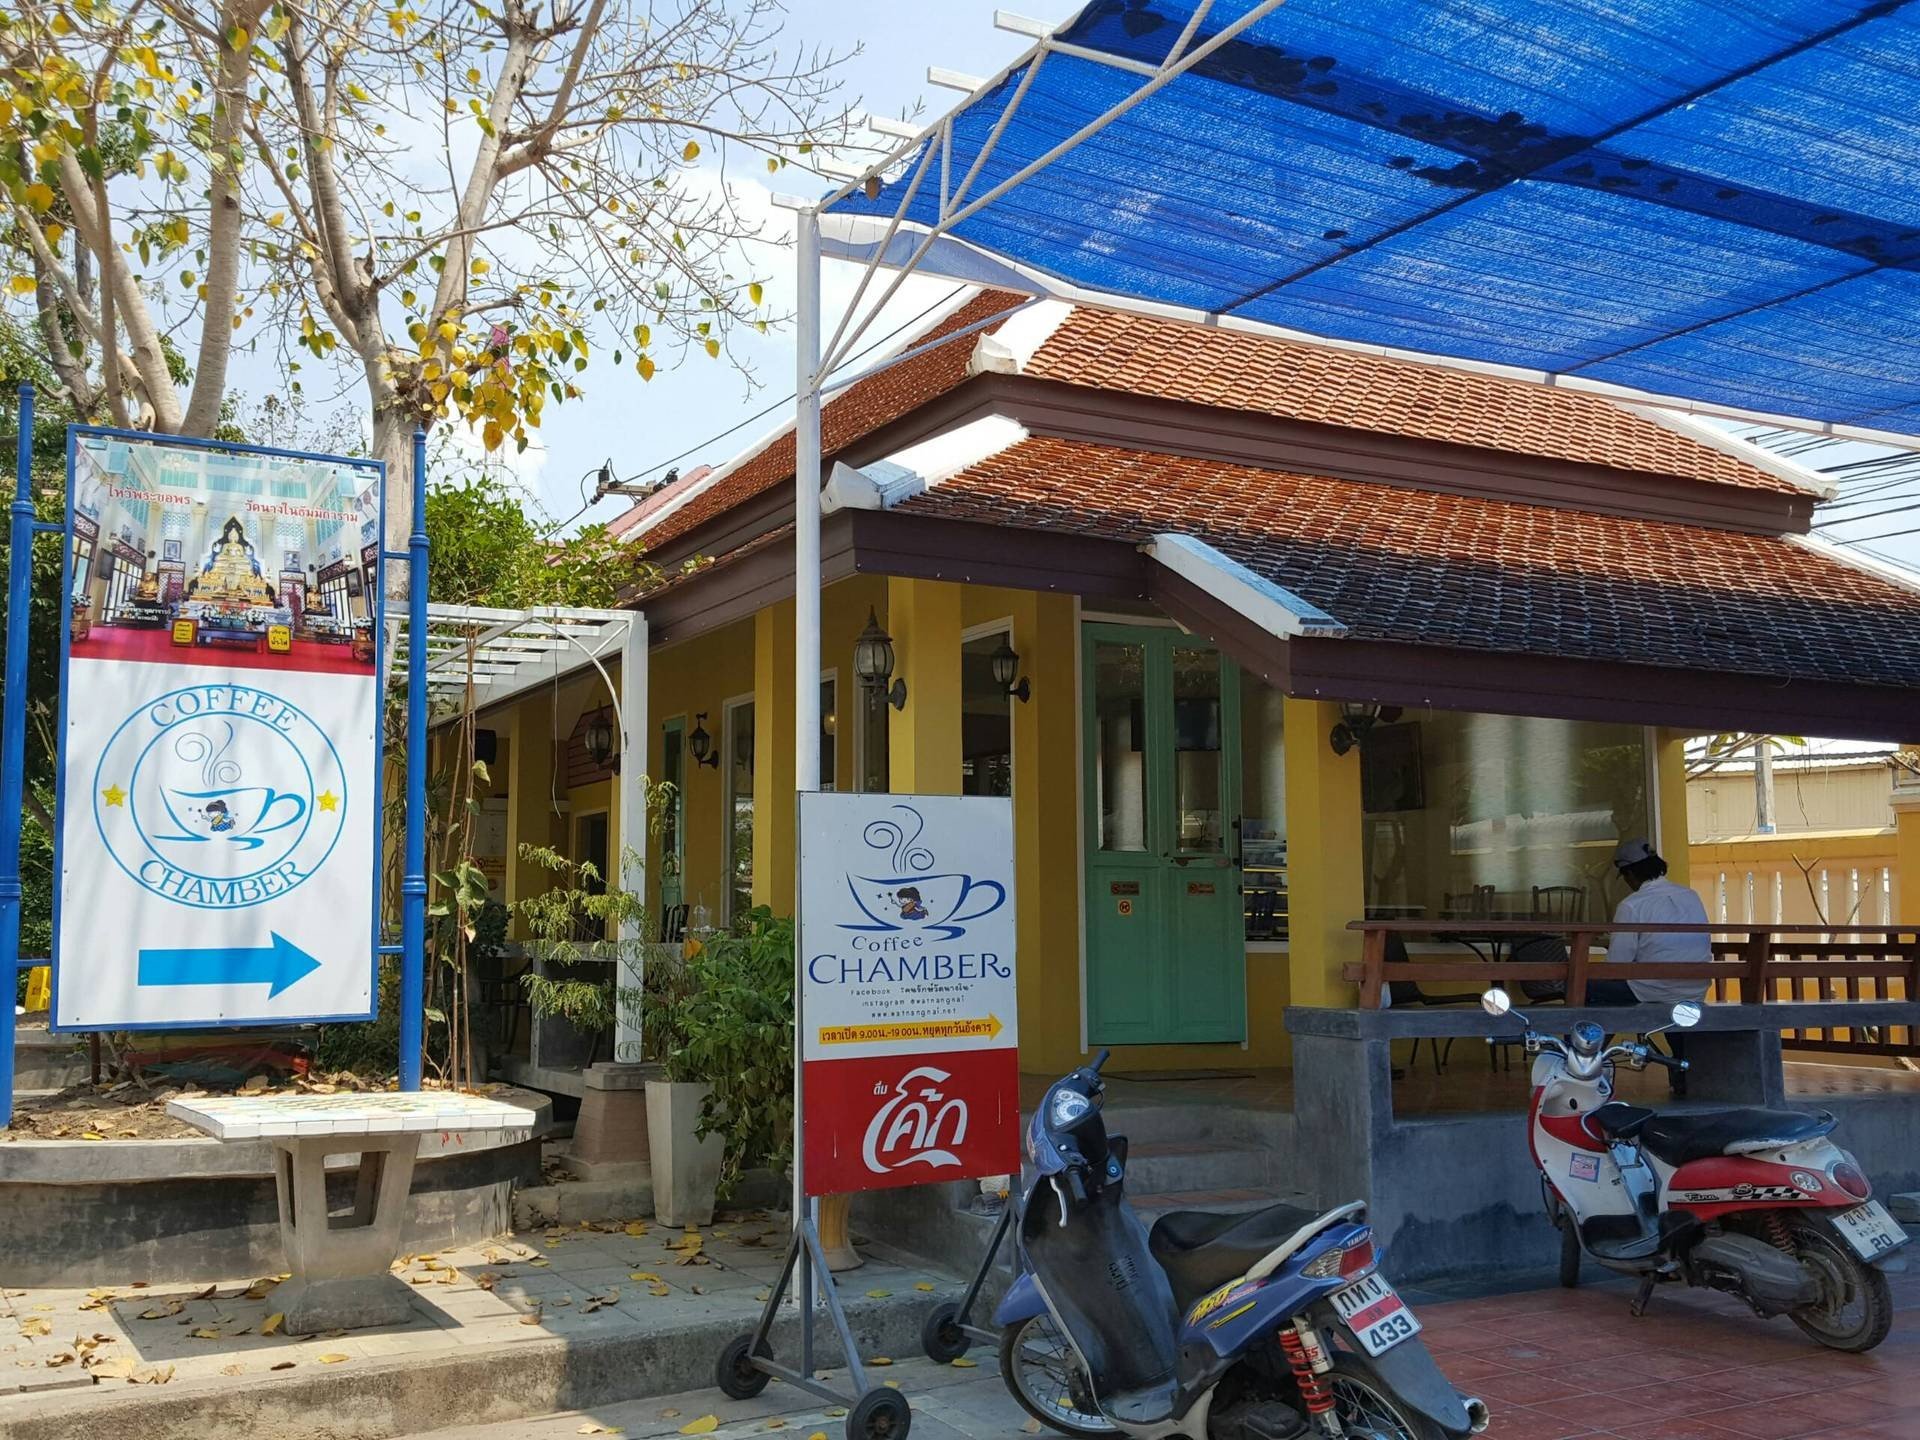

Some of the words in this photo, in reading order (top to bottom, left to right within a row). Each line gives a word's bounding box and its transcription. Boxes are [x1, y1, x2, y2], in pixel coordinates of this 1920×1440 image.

[150, 686, 298, 731] COFFEE
[140, 860, 307, 905] CHAMBER
[852, 936, 923, 951] Coffee
[808, 953, 1011, 984] CHAMBER
[1369, 1314, 1412, 1348] 433
